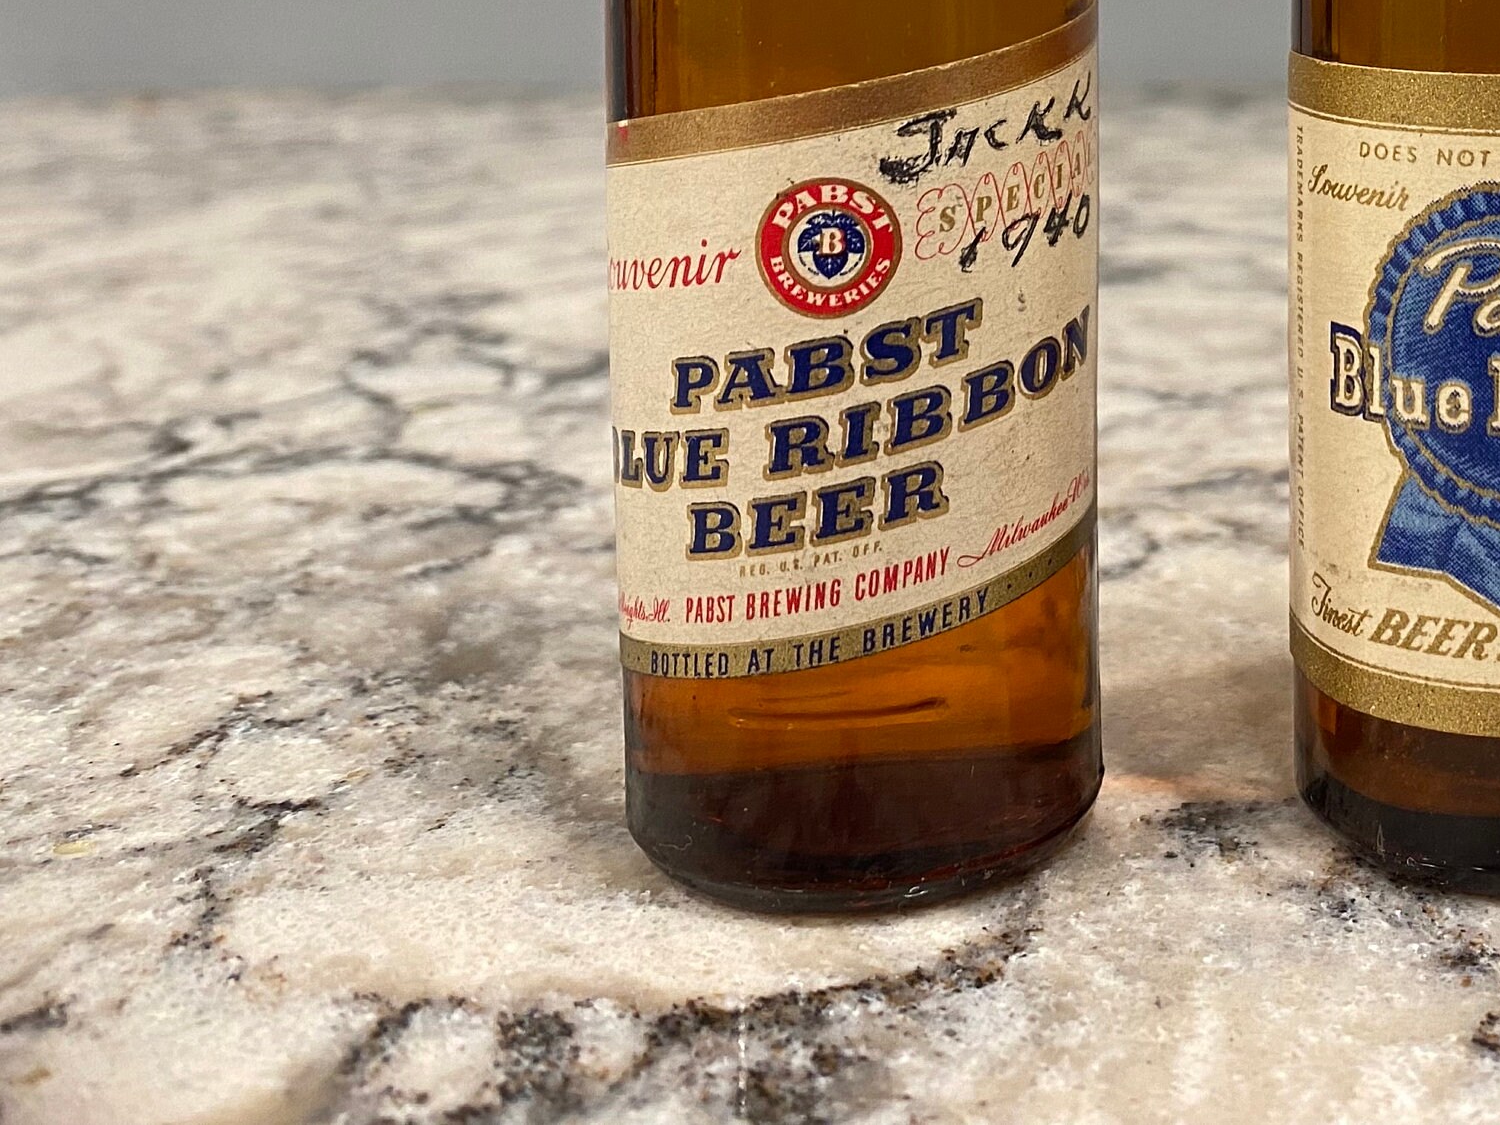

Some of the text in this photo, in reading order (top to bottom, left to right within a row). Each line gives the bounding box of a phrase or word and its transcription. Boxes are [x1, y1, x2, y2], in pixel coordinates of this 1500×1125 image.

[1296, 126, 1304, 243] TRADEMARKS
[1307, 163, 1409, 212] Souvenir
[1359, 141, 1418, 163] DOES
[1436, 149, 1492, 168] NOT
[772, 183, 895, 234] PABST
[820, 227, 844, 255] B
[609, 238, 742, 291] ouvenir
[770, 257, 891, 308] BREWERIES
[1296, 251, 1305, 358] REGISTERED
[670, 297, 983, 414] PABST
[1330, 321, 1473, 433] Blue
[612, 304, 1089, 493] LUE RIBBON
[1297, 412, 1305, 478] PATENT
[686, 460, 949, 561] BEER
[1297, 486, 1306, 550] OFFICE
[686, 594, 736, 624] PABST
[745, 578, 842, 621] BREWING
[854, 546, 951, 602] COMPANY
[1311, 571, 1374, 637] Finest
[1369, 607, 1500, 661] BEER
[651, 586, 989, 678] BOTTLED AT THE BREWERY
